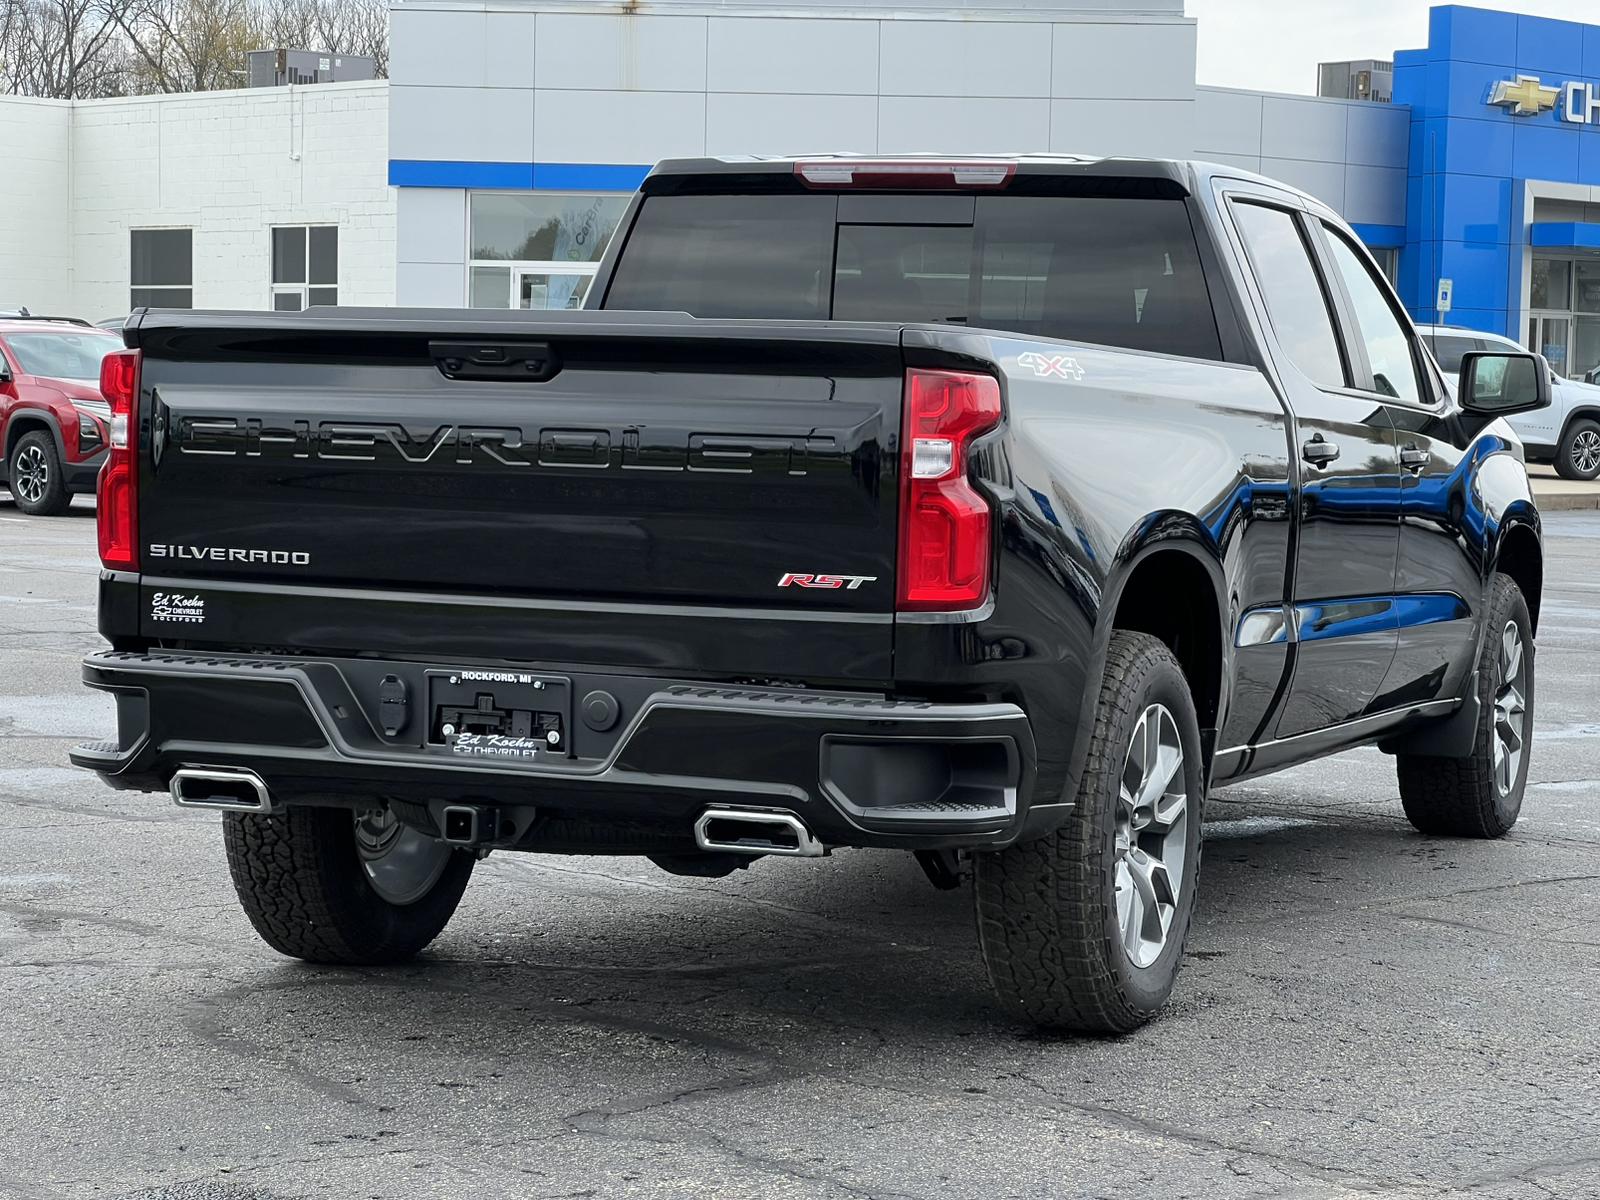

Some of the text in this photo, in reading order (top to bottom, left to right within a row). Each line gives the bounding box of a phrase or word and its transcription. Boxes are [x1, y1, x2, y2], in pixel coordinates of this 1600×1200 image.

[179, 416, 837, 476] CHEVROLET
[150, 544, 310, 565] SILVERADO
[778, 573, 877, 590] RST
[152, 593, 204, 607] Ed Koehn
[172, 608, 203, 616] CHEVROLET
[461, 671, 532, 684] ROCKFORD, MI
[457, 732, 535, 749] Ed Koehn
